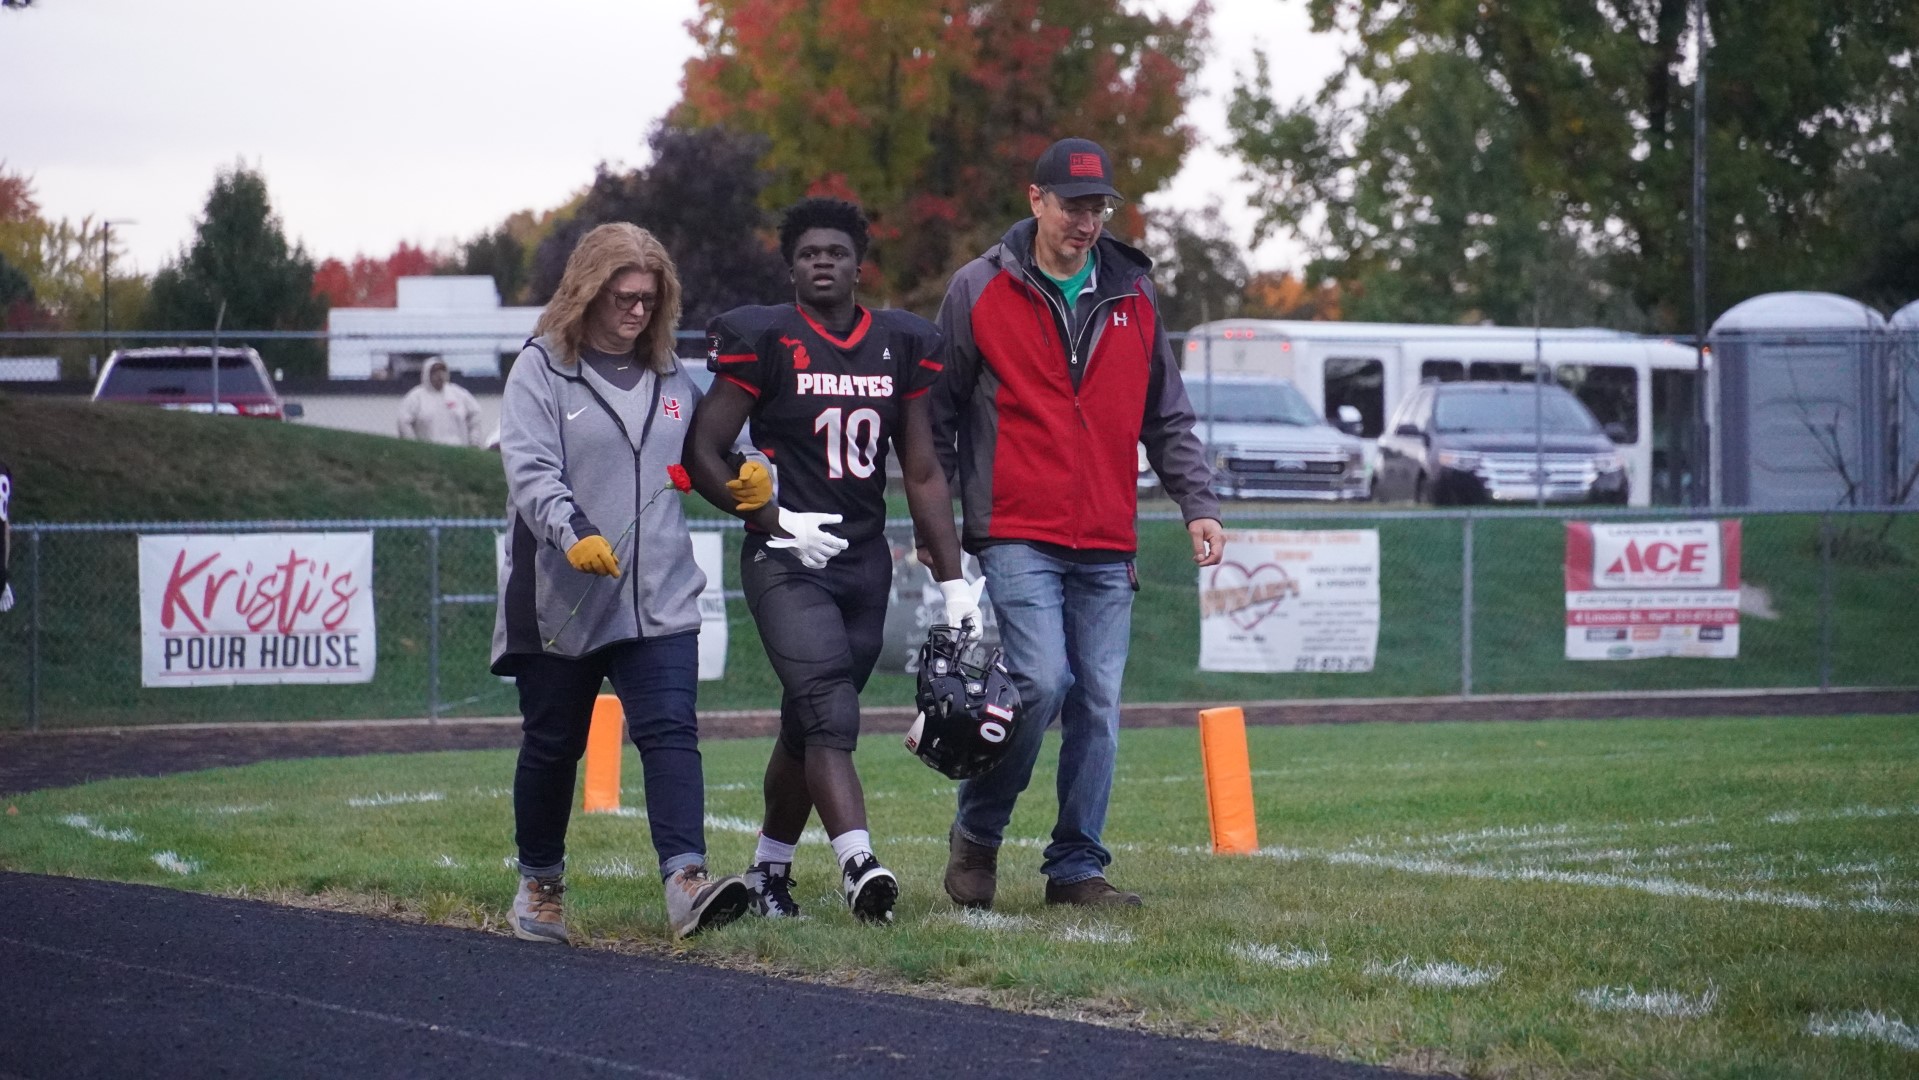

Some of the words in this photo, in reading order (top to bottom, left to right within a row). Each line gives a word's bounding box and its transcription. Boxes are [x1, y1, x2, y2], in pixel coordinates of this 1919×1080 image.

[1113, 311, 1128, 326] H
[796, 373, 894, 397] PIRATES
[662, 395, 682, 421] H
[814, 407, 881, 479] 10
[1605, 538, 1708, 573] ACE
[160, 548, 358, 634] Kristi's
[165, 636, 246, 671] POUR
[260, 634, 360, 668] HOUSE
[980, 703, 1014, 744] 10
